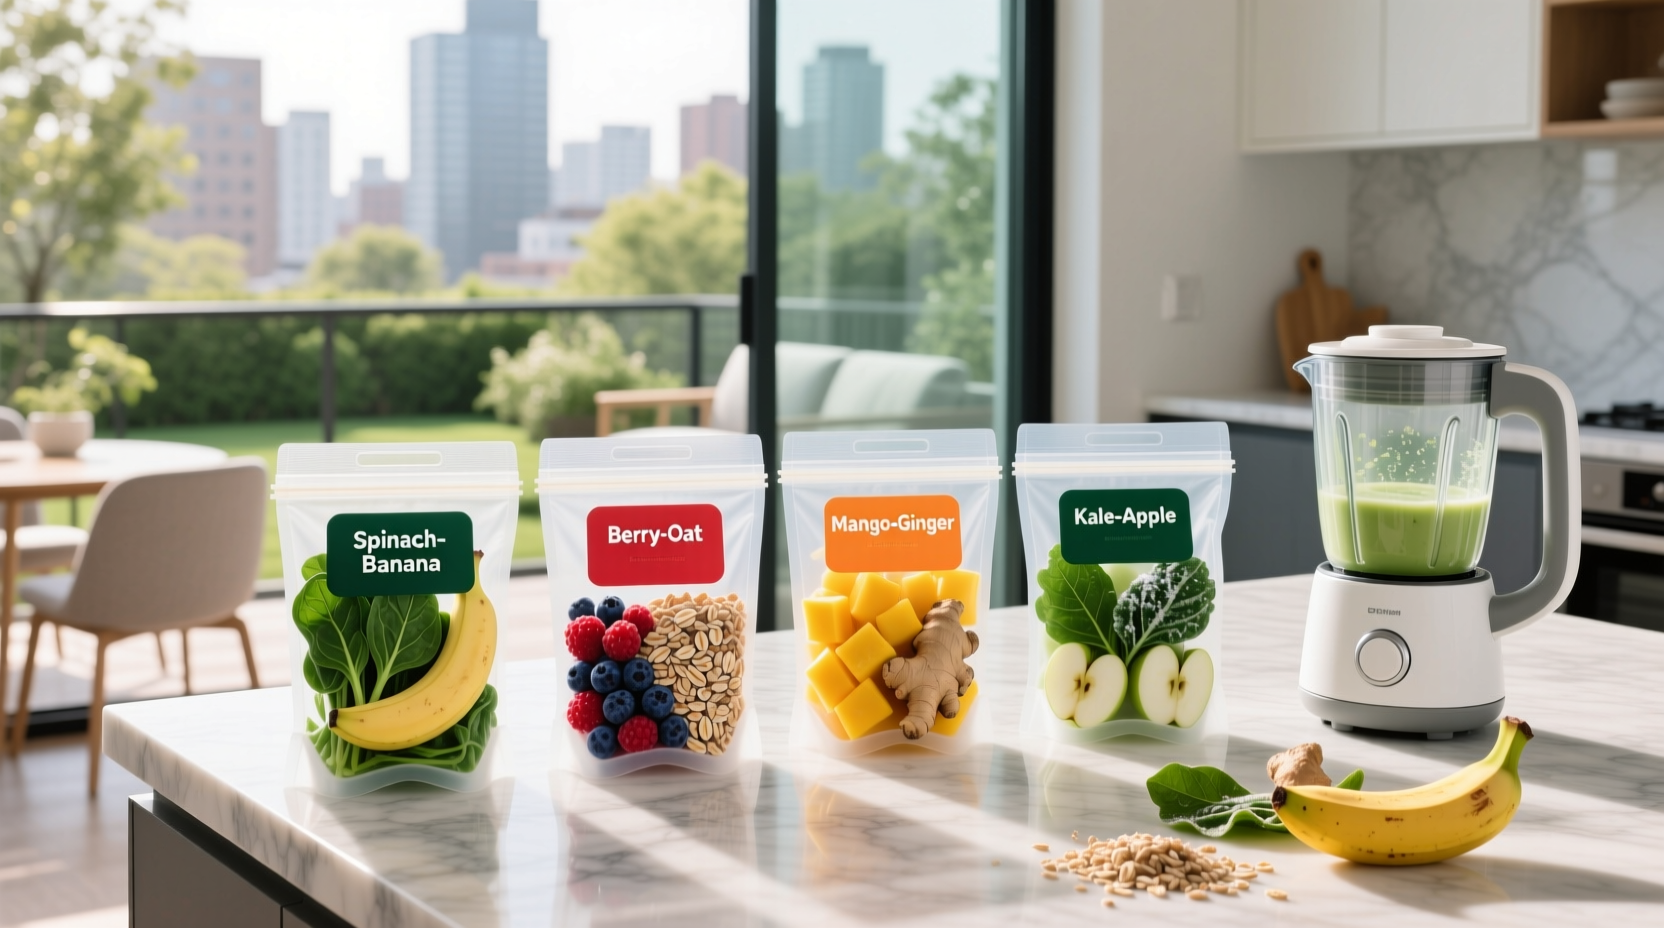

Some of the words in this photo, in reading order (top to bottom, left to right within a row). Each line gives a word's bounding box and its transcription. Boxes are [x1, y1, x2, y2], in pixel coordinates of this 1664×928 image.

[831, 513, 955, 537] Mango-Ginger
[1074, 505, 1177, 529] Kale-Apple
[353, 528, 446, 554] Spinach-
[608, 523, 704, 548] Berry-Oat
[362, 554, 441, 574] Banana
